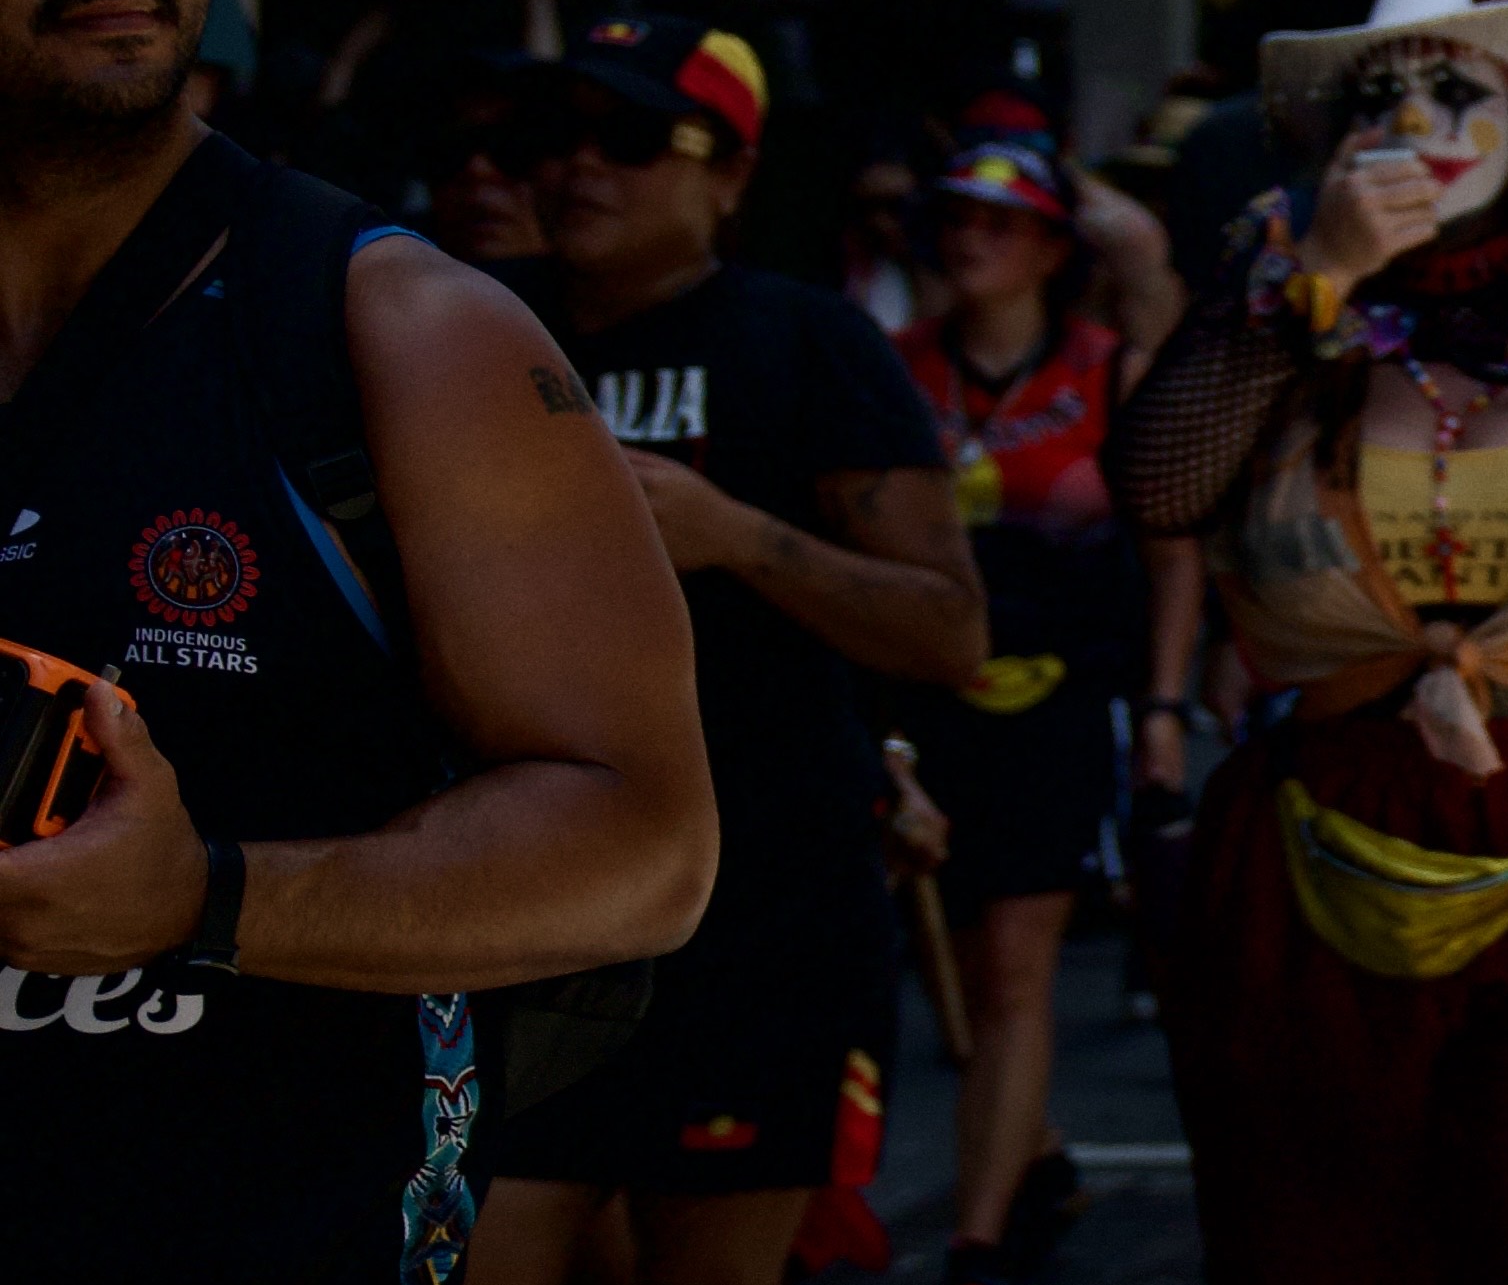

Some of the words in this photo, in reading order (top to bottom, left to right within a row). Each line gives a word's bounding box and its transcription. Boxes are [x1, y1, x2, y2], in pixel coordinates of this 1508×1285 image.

[135, 627, 248, 652] INDIGENOUS
[124, 643, 170, 665] ALL
[176, 647, 260, 675] STARS
